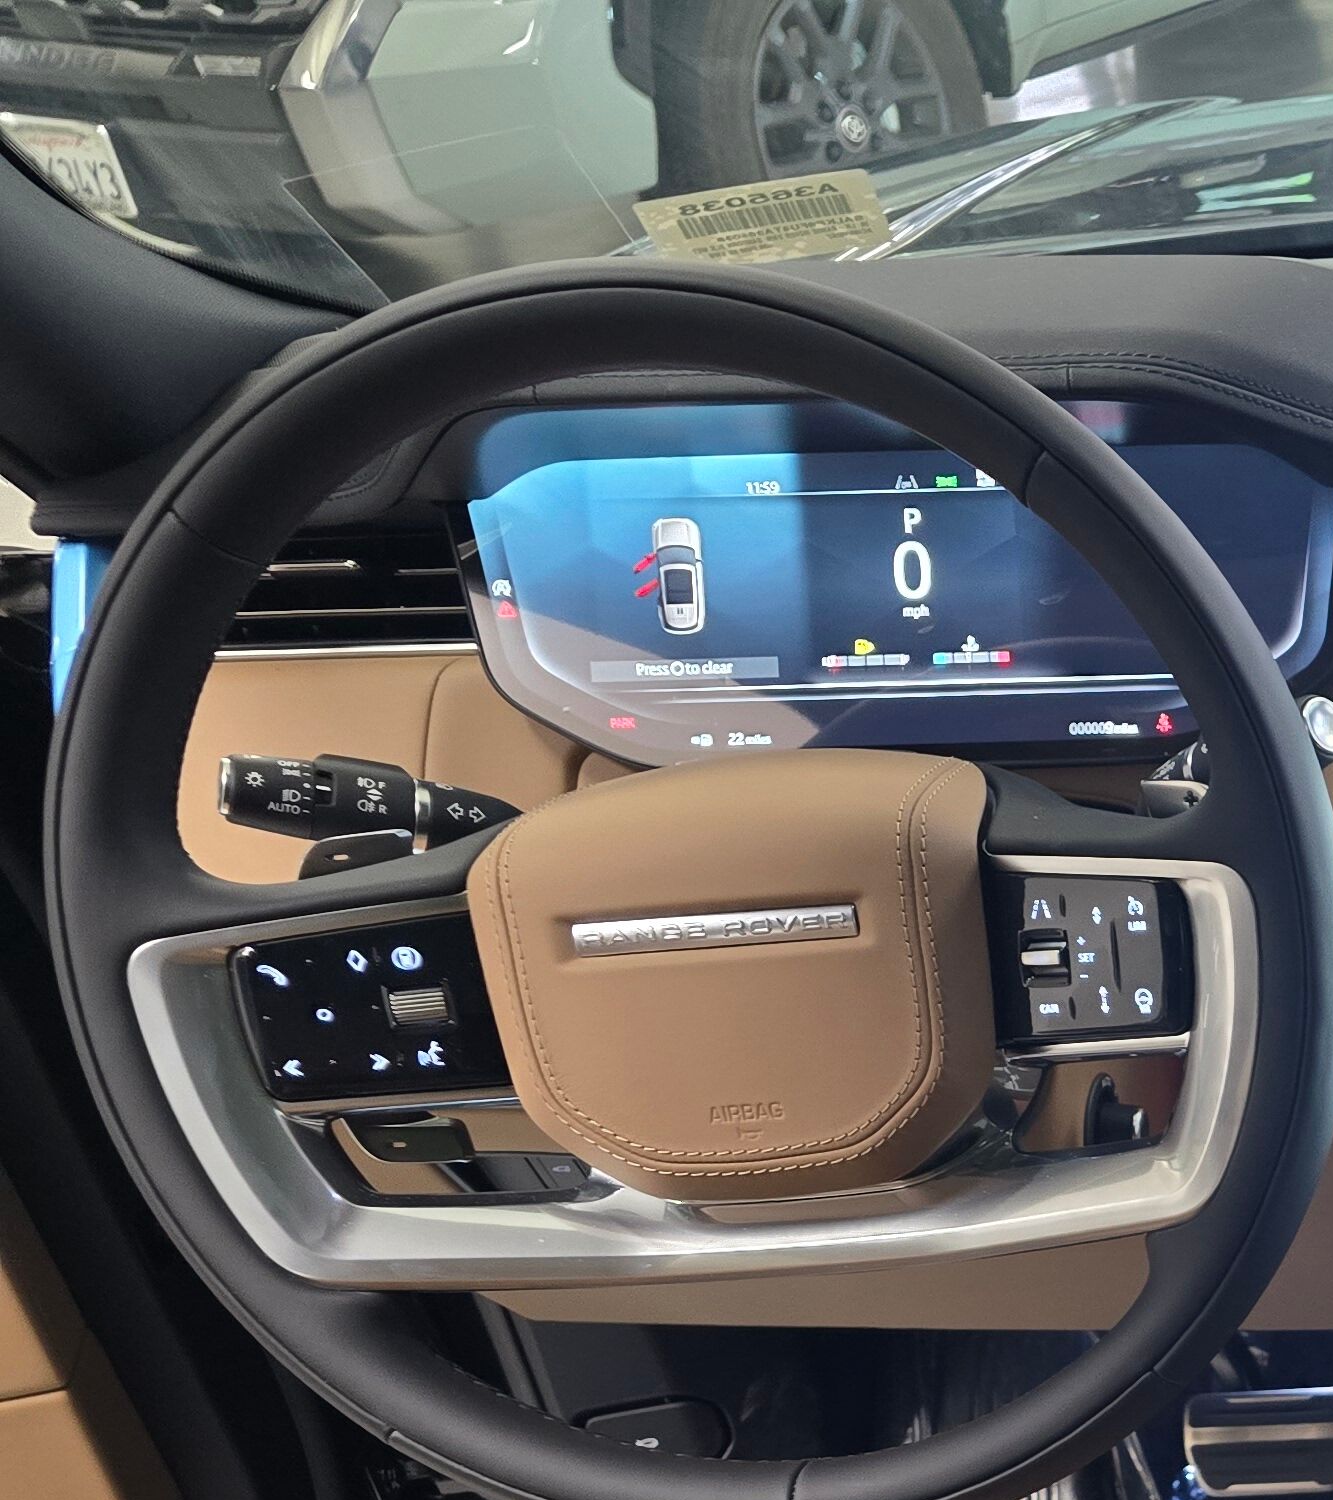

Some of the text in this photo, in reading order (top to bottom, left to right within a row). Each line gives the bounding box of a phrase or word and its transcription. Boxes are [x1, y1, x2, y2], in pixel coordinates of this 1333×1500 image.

[745, 481, 780, 495] 11:59
[904, 508, 922, 534] P
[893, 540, 932, 600] 0
[902, 604, 930, 619] mph
[635, 660, 734, 676] Press to clear
[609, 716, 636, 729] PARK
[727, 731, 746, 746] 22
[378, 781, 387, 789] F
[267, 801, 301, 815] AUTO
[378, 804, 388, 815] R
[723, 911, 849, 937] ROVER
[1077, 952, 1096, 963] SET
[709, 1101, 785, 1125] AIRBAG
